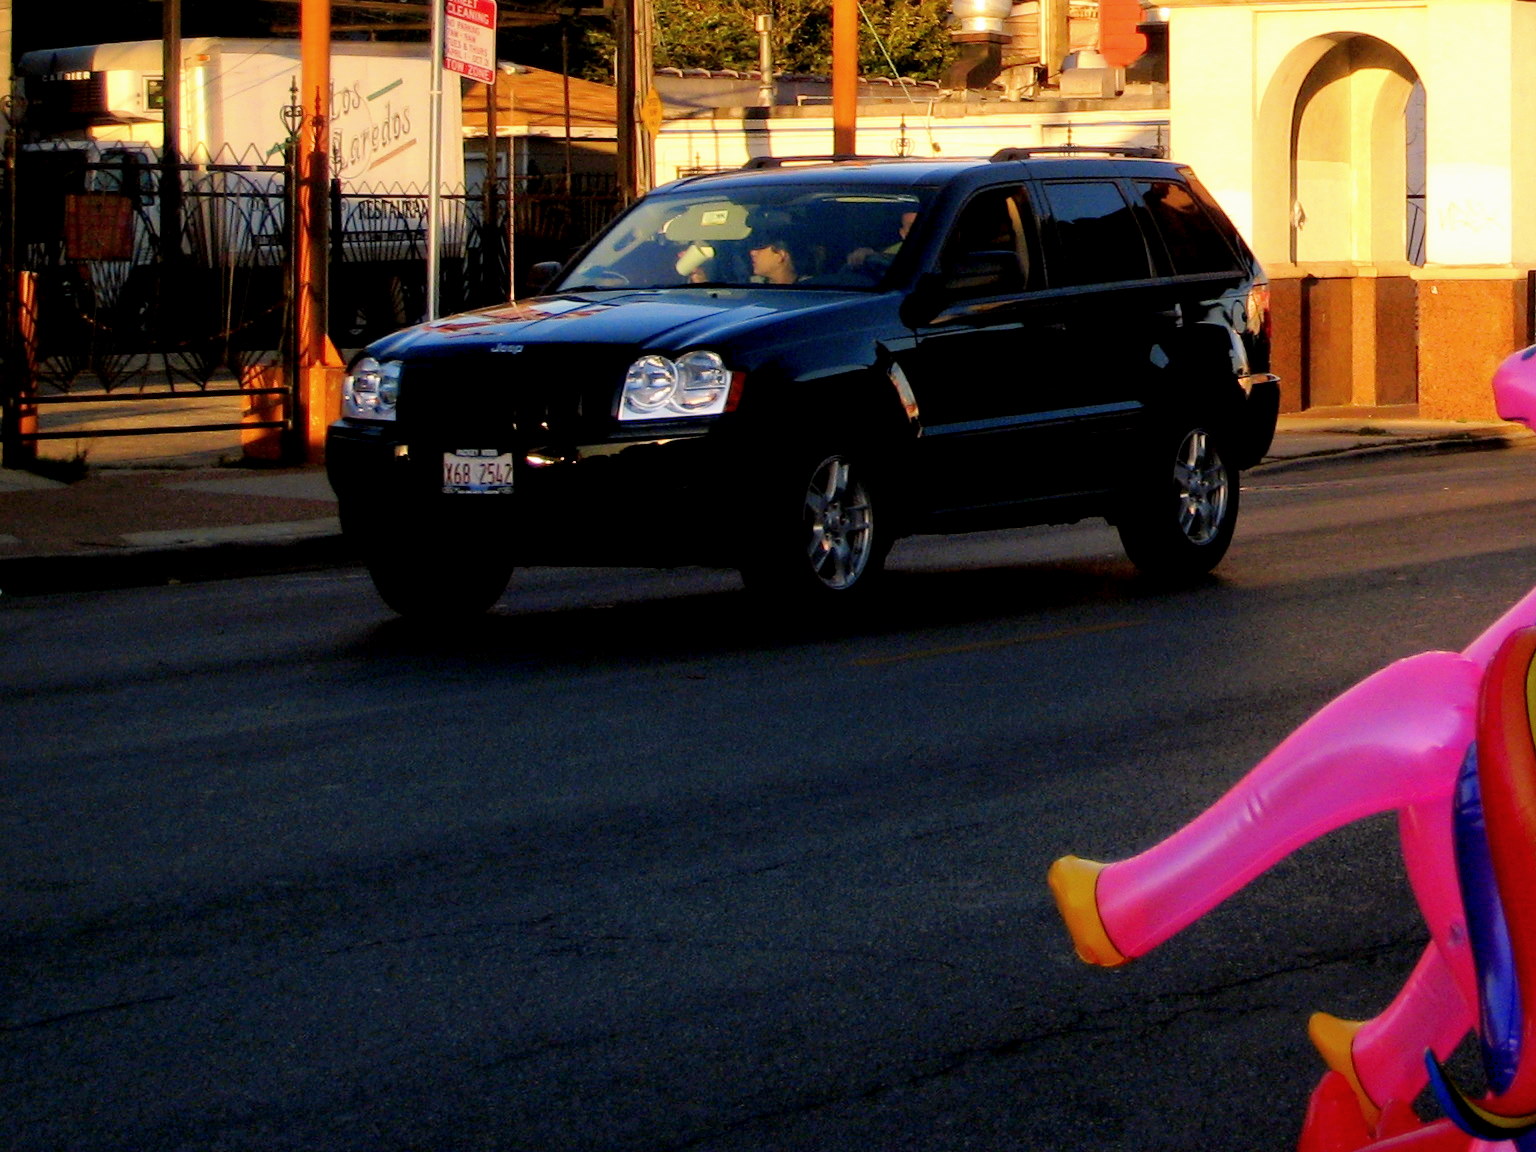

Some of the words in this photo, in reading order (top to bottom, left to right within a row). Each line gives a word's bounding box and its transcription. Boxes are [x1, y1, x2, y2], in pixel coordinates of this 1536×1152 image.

[447, 4, 490, 25] CLEANING
[446, 58, 463, 71] TOW
[467, 63, 491, 81] ZONE
[331, 79, 361, 122] Los
[360, 199, 430, 220] RESTAURAN
[491, 343, 524, 354] Jeep
[480, 463, 513, 485] 2542
